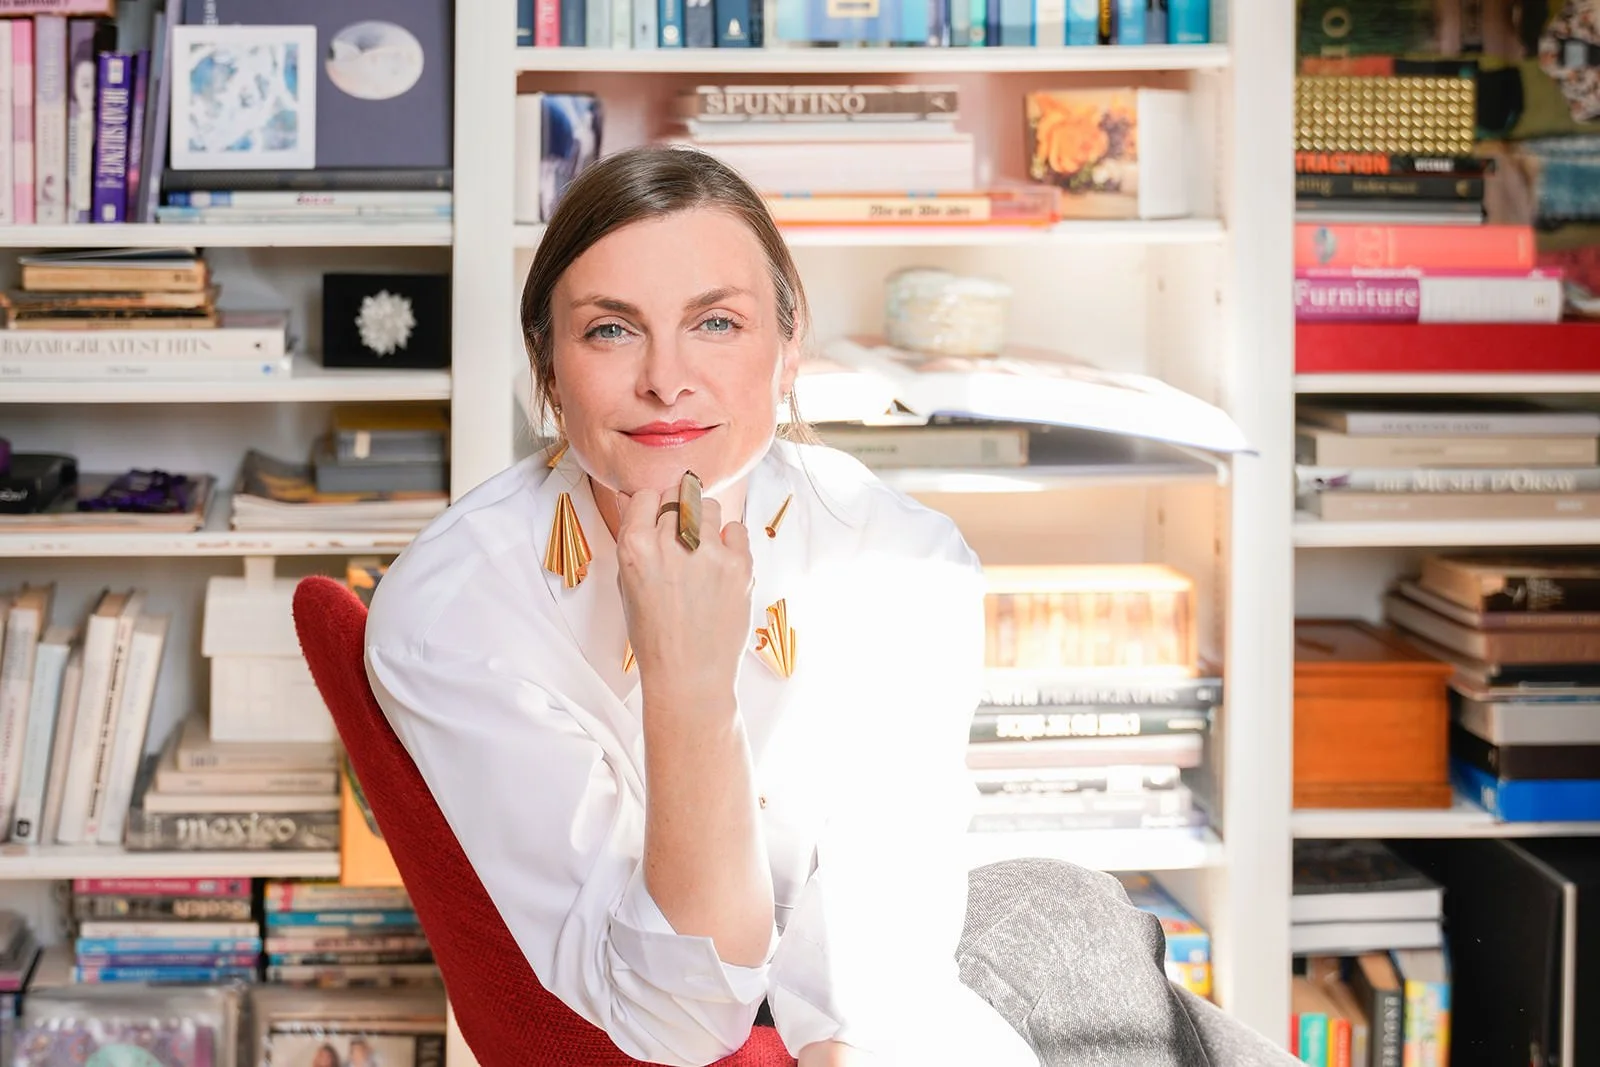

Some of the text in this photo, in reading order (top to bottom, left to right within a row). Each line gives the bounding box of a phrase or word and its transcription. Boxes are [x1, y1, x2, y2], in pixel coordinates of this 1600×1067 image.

[705, 92, 866, 114] SPUNTINO
[1295, 278, 1418, 307] Furniture
[175, 811, 297, 843] mexico
